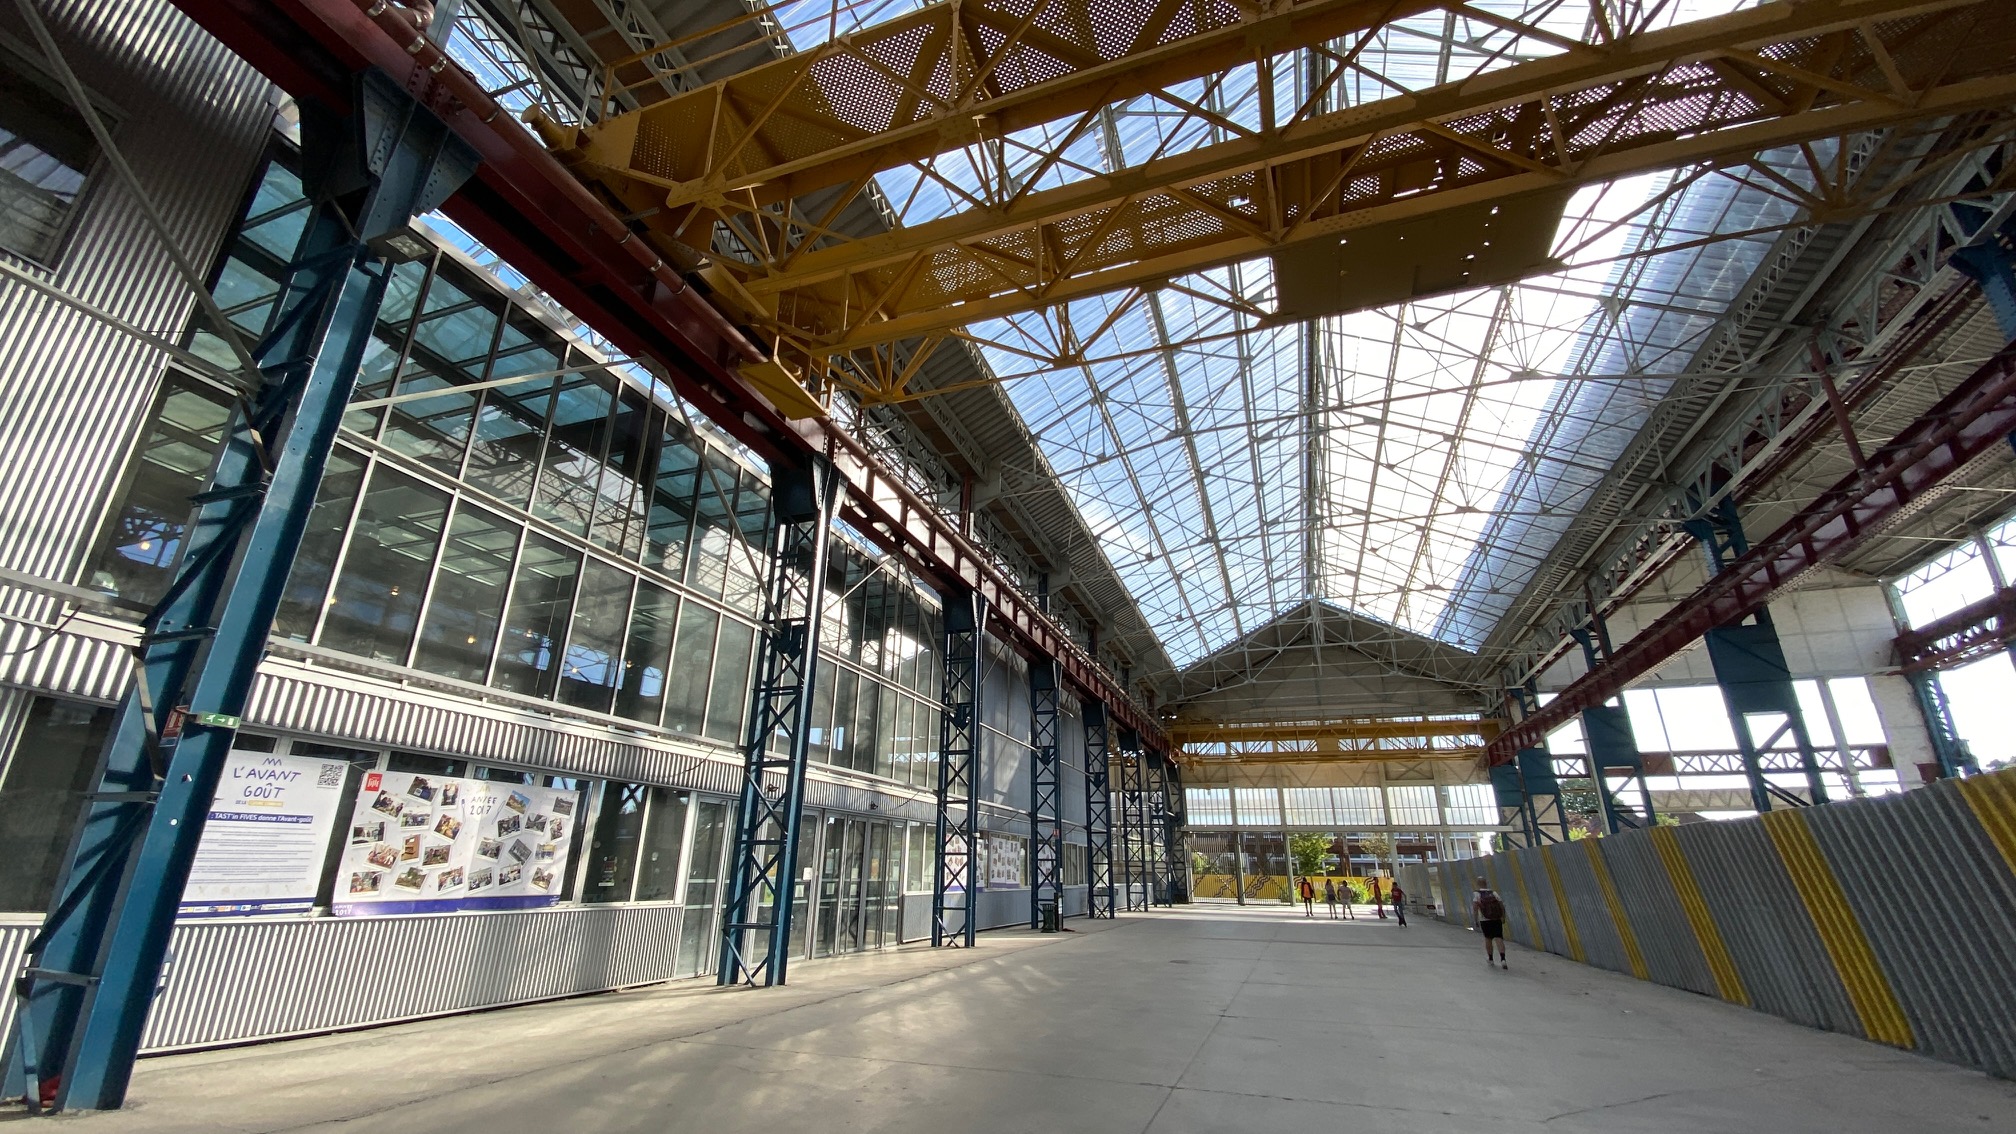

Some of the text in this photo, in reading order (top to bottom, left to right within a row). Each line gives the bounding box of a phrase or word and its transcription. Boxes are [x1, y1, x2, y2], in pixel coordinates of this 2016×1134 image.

[233, 766, 302, 782] L'AVANT
[243, 782, 285, 799] GOÛT
[470, 805, 492, 815] 2017
[239, 813, 258, 821] FIVES
